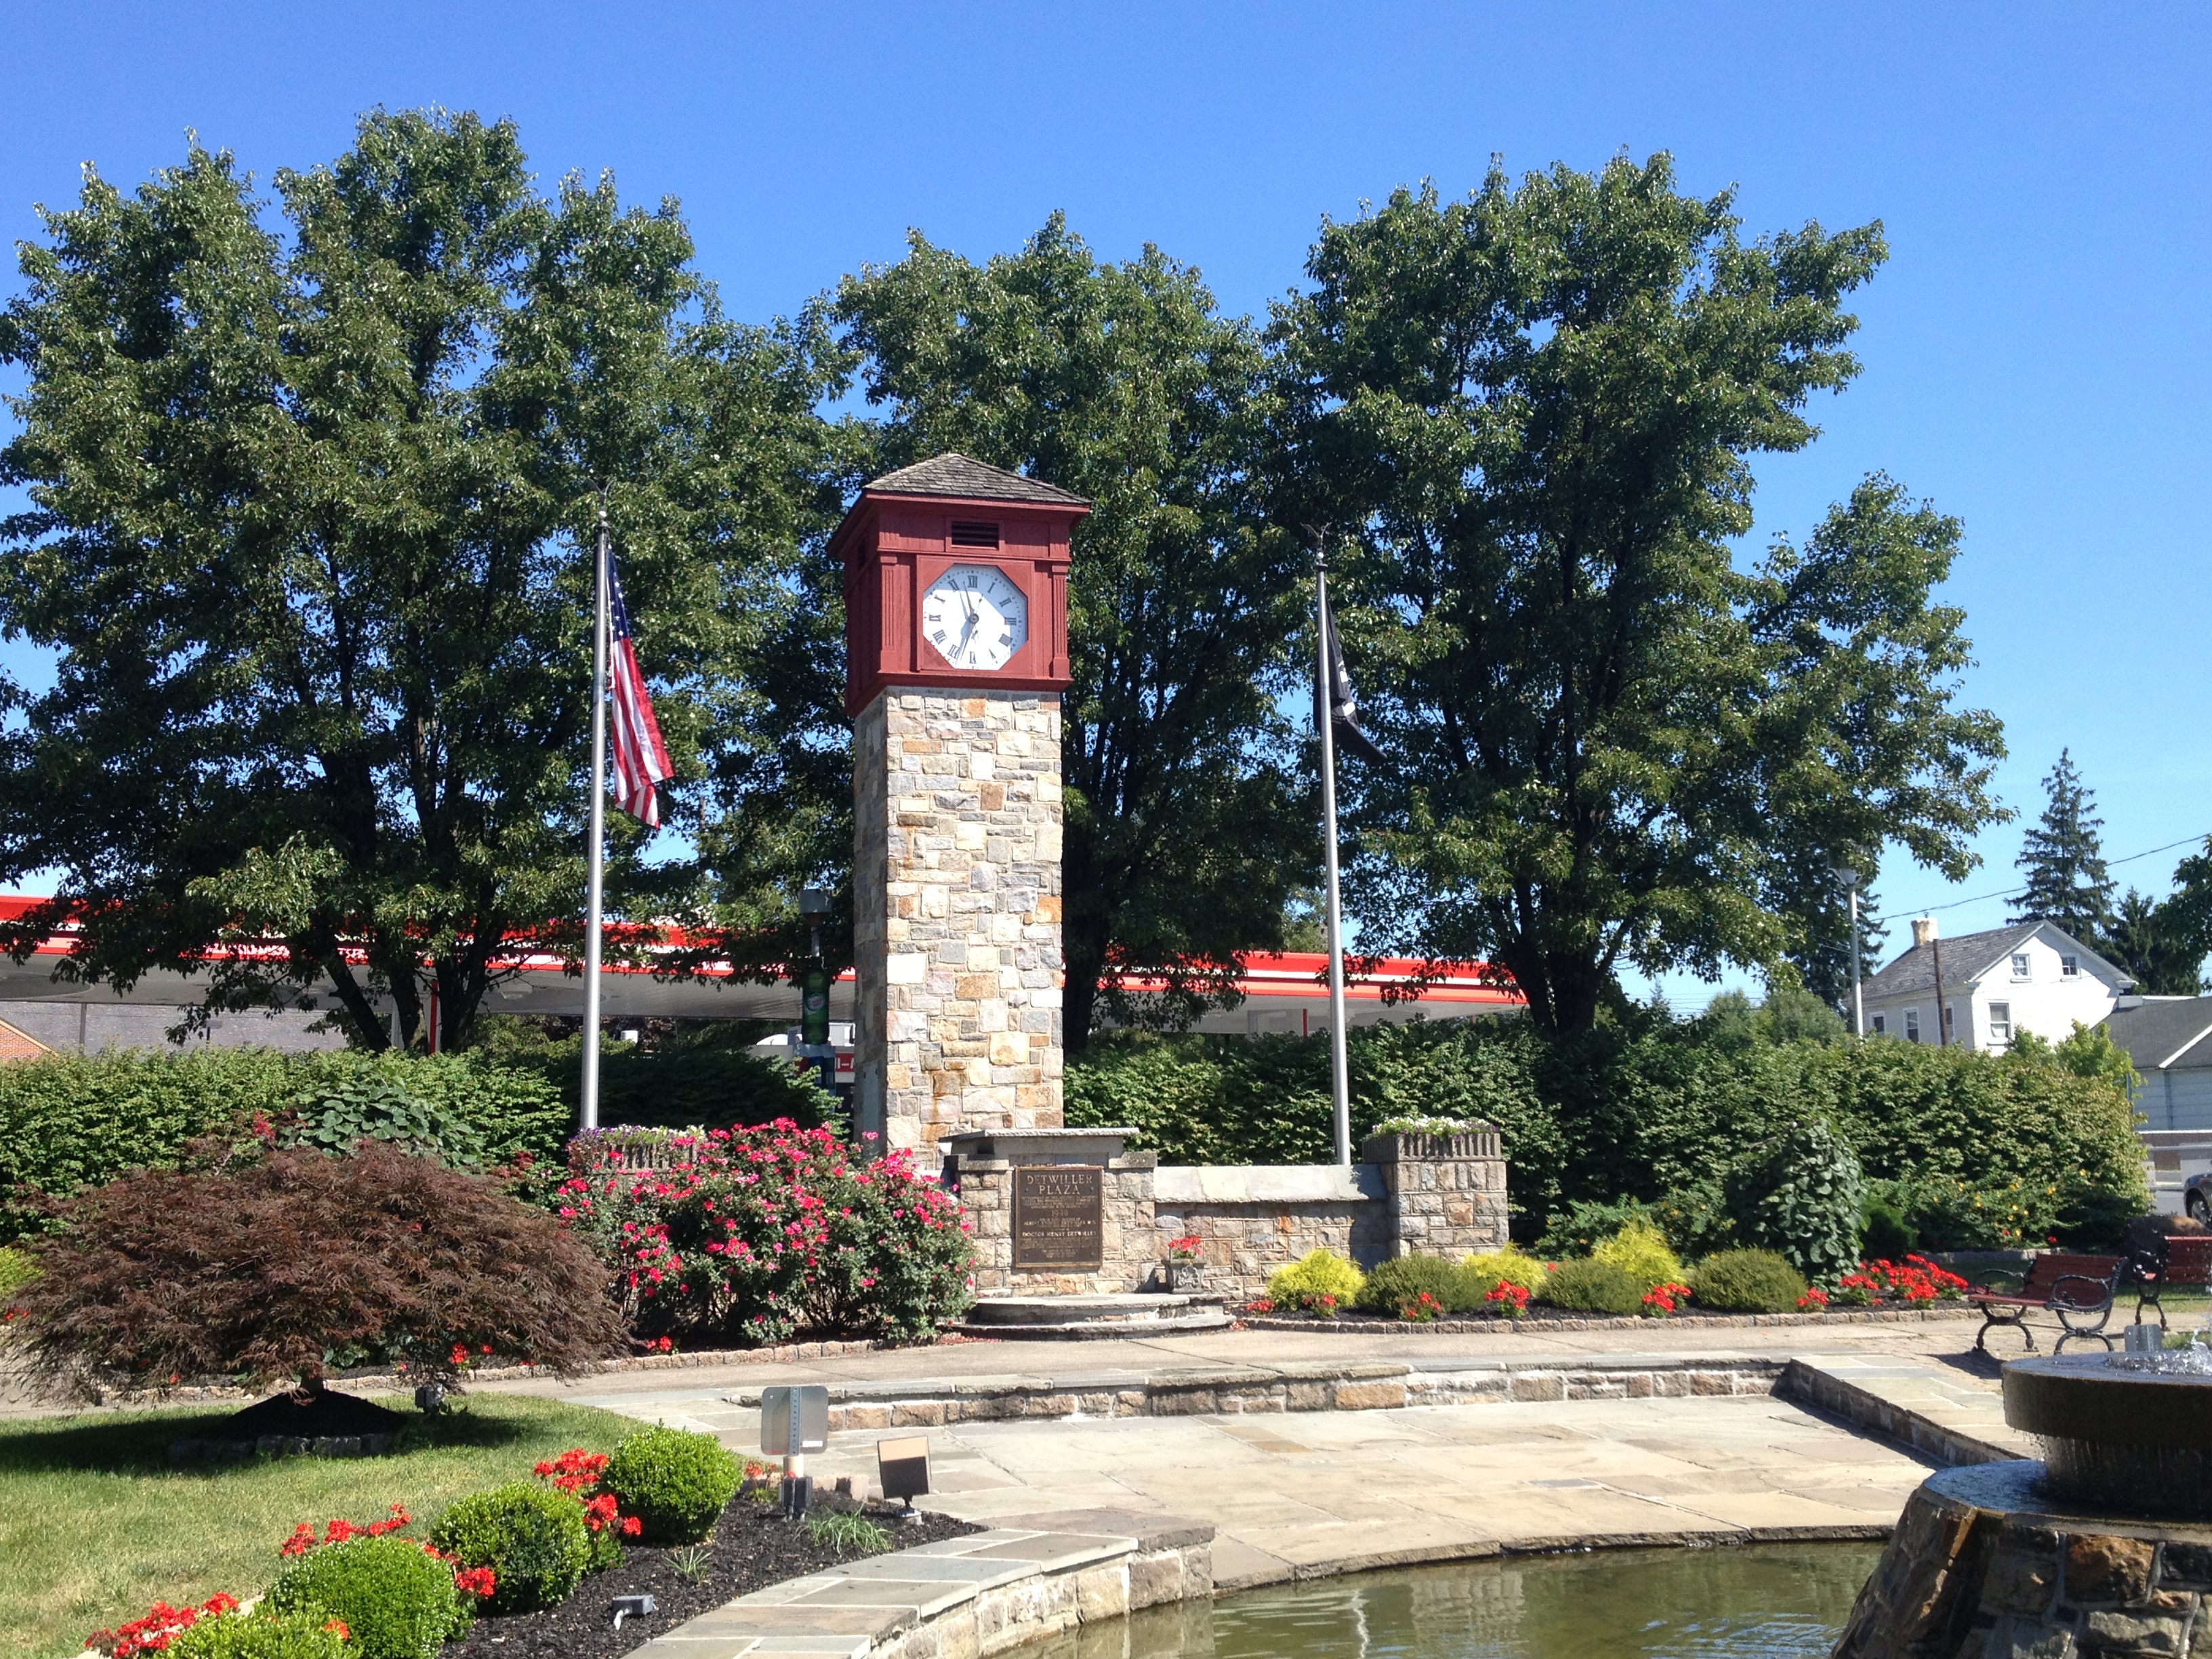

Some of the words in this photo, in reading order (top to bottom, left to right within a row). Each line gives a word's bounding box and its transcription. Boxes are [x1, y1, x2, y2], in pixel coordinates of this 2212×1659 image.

[967, 575, 978, 588] XII
[987, 582, 996, 594] I
[934, 594, 946, 605] X
[999, 597, 1012, 607] II
[928, 614, 941, 622] IX
[1004, 617, 1017, 626] III
[1027, 1174, 1092, 1185] DETWILLER
[1039, 1185, 1080, 1195] PLAZA
